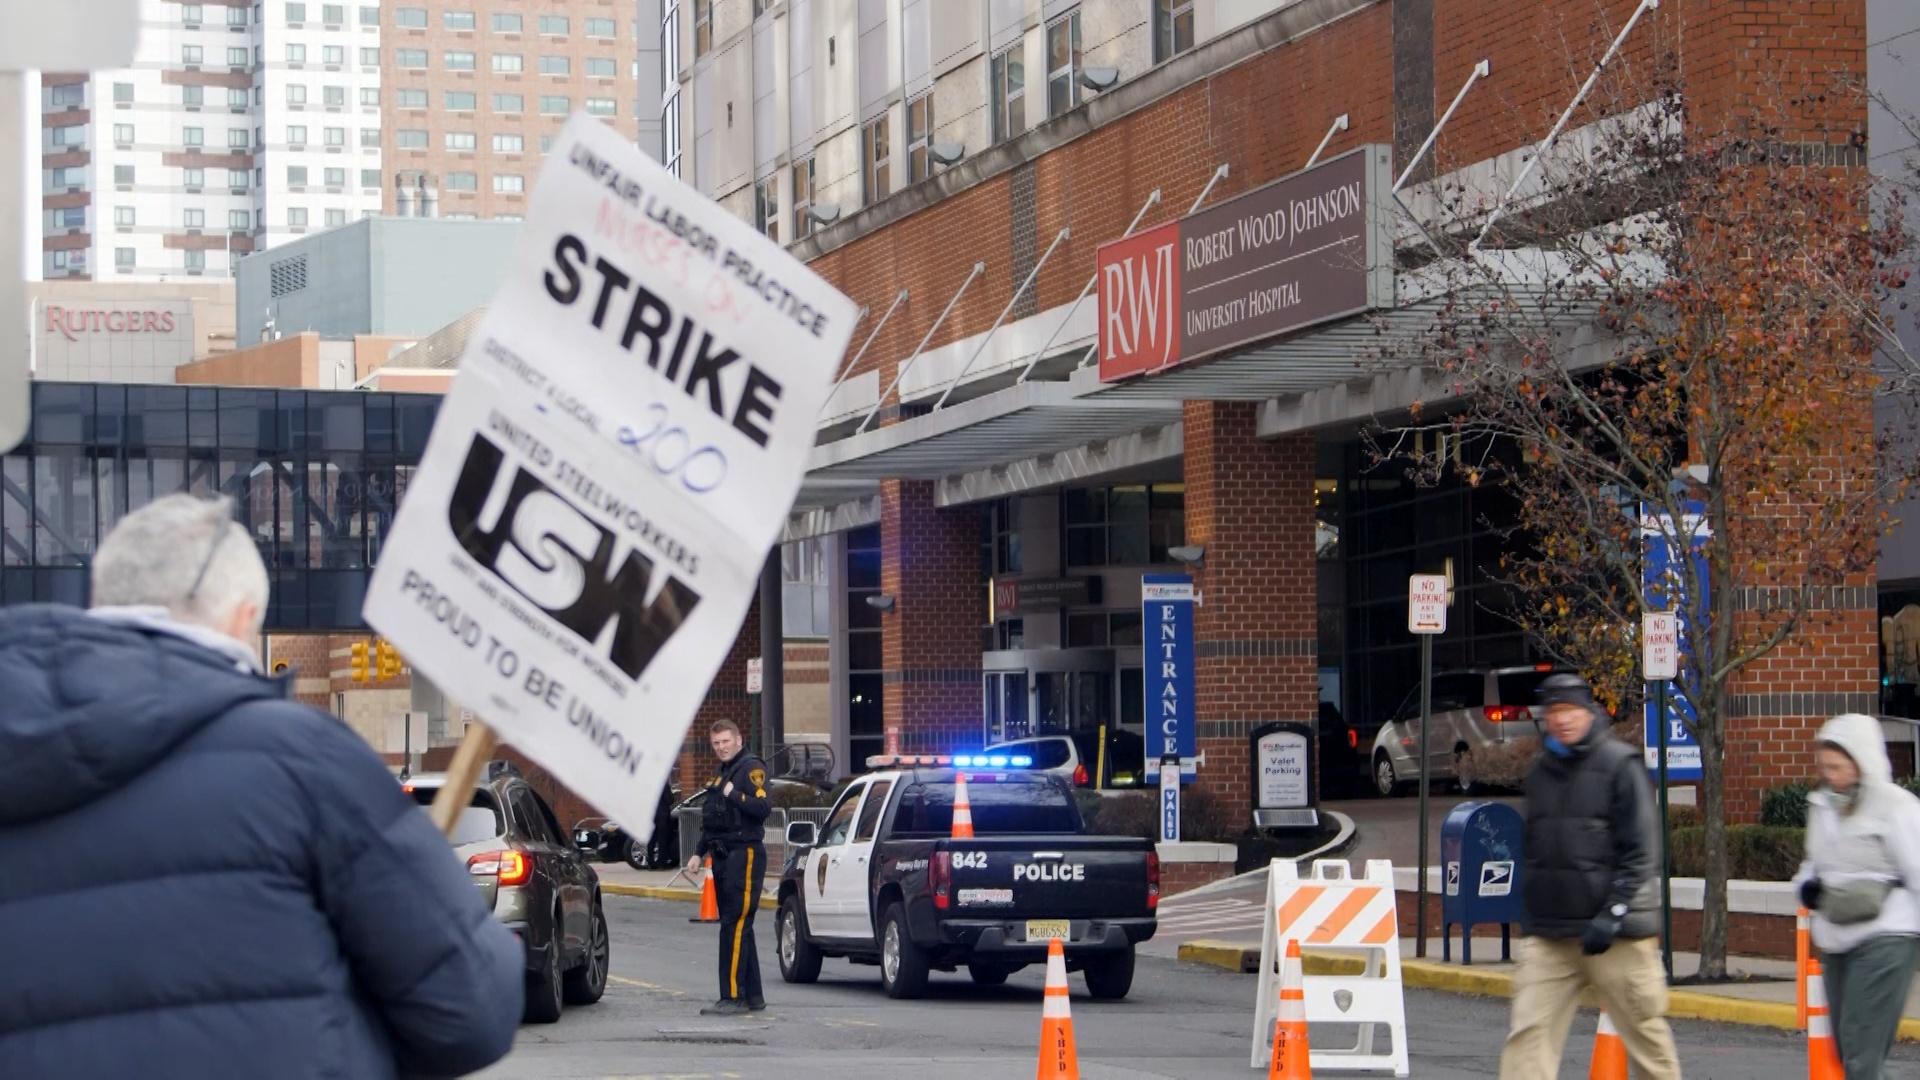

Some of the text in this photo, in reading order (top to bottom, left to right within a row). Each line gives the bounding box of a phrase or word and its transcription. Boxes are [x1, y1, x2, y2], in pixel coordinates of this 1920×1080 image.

[570, 142, 828, 338] UNFAIR LABOR PRACTICE
[1186, 181, 1361, 272] ROBERT WOOD JOHNSON
[46, 304, 176, 342] RUTGERS
[1104, 243, 1174, 365] RWJ
[1187, 280, 1302, 336] UNIVERSITY HOSPITAL
[544, 233, 783, 449] STRIKE
[484, 337, 547, 389] DISTRICT
[555, 389, 600, 433] LOCAL
[617, 402, 728, 493] 200
[488, 408, 700, 575] UNITED STEELWORKERS
[448, 431, 701, 682] USW
[1413, 593, 1445, 603] PARKING
[1422, 581, 1435, 591] NO
[1646, 633, 1673, 645] PARKING
[1653, 619, 1666, 630] NO
[402, 569, 644, 776] PROUD TO BE UNION
[1161, 605, 1178, 754] ENTRANCE
[1265, 767, 1301, 776] Parking
[1271, 757, 1296, 766] Valet
[1165, 791, 1176, 838] VALET
[952, 851, 988, 869] 842
[1014, 864, 1085, 881] POLICE
